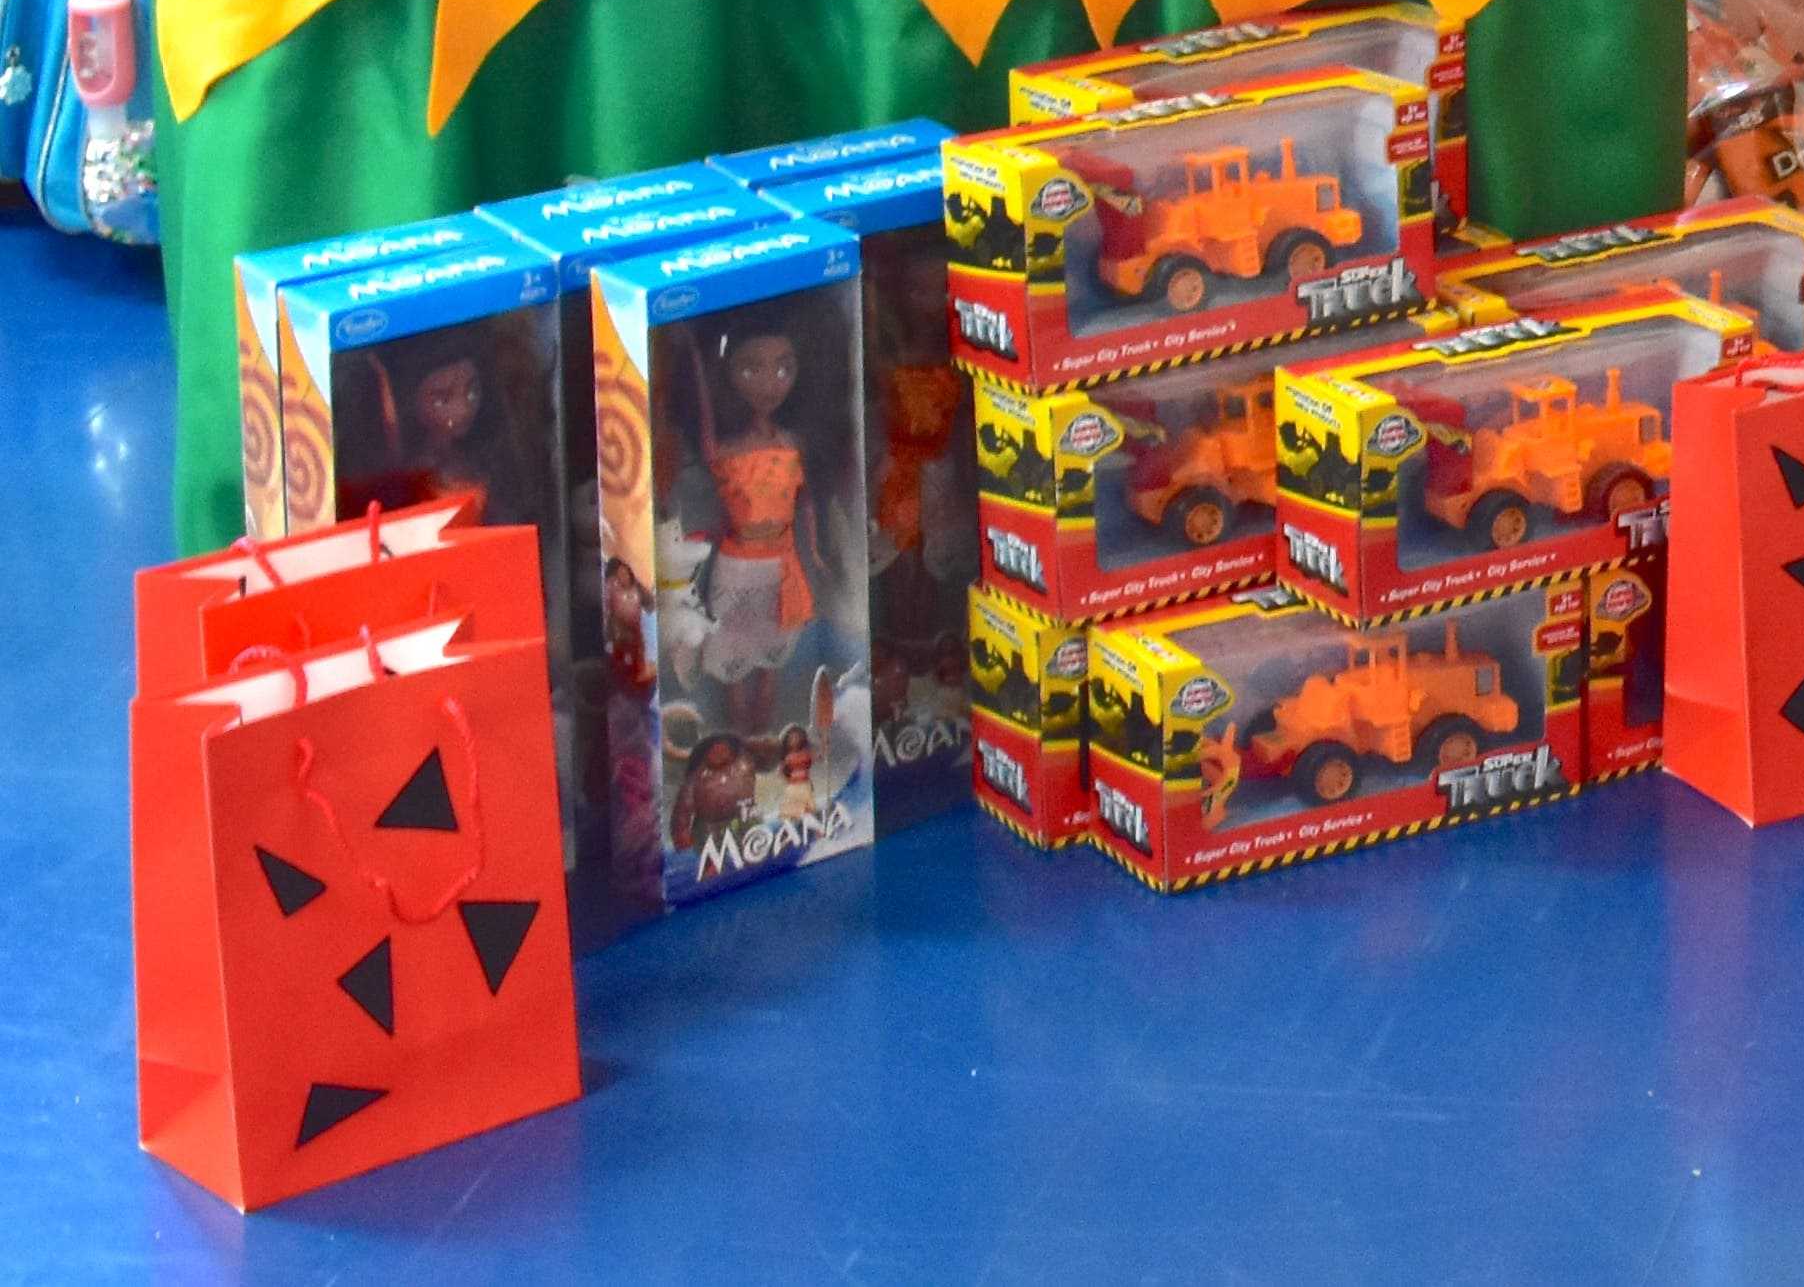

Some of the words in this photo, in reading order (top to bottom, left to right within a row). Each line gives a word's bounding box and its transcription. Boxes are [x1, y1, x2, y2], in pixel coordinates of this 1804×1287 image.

[1097, 348, 1119, 364] City
[1164, 334, 1186, 350] City
[1124, 580, 1146, 597] City
[1191, 565, 1213, 579] City
[1422, 579, 1443, 595] City
[1487, 563, 1507, 577] City
[696, 800, 852, 882] MOANA
[1229, 839, 1252, 855] City
[1298, 824, 1321, 840] City
